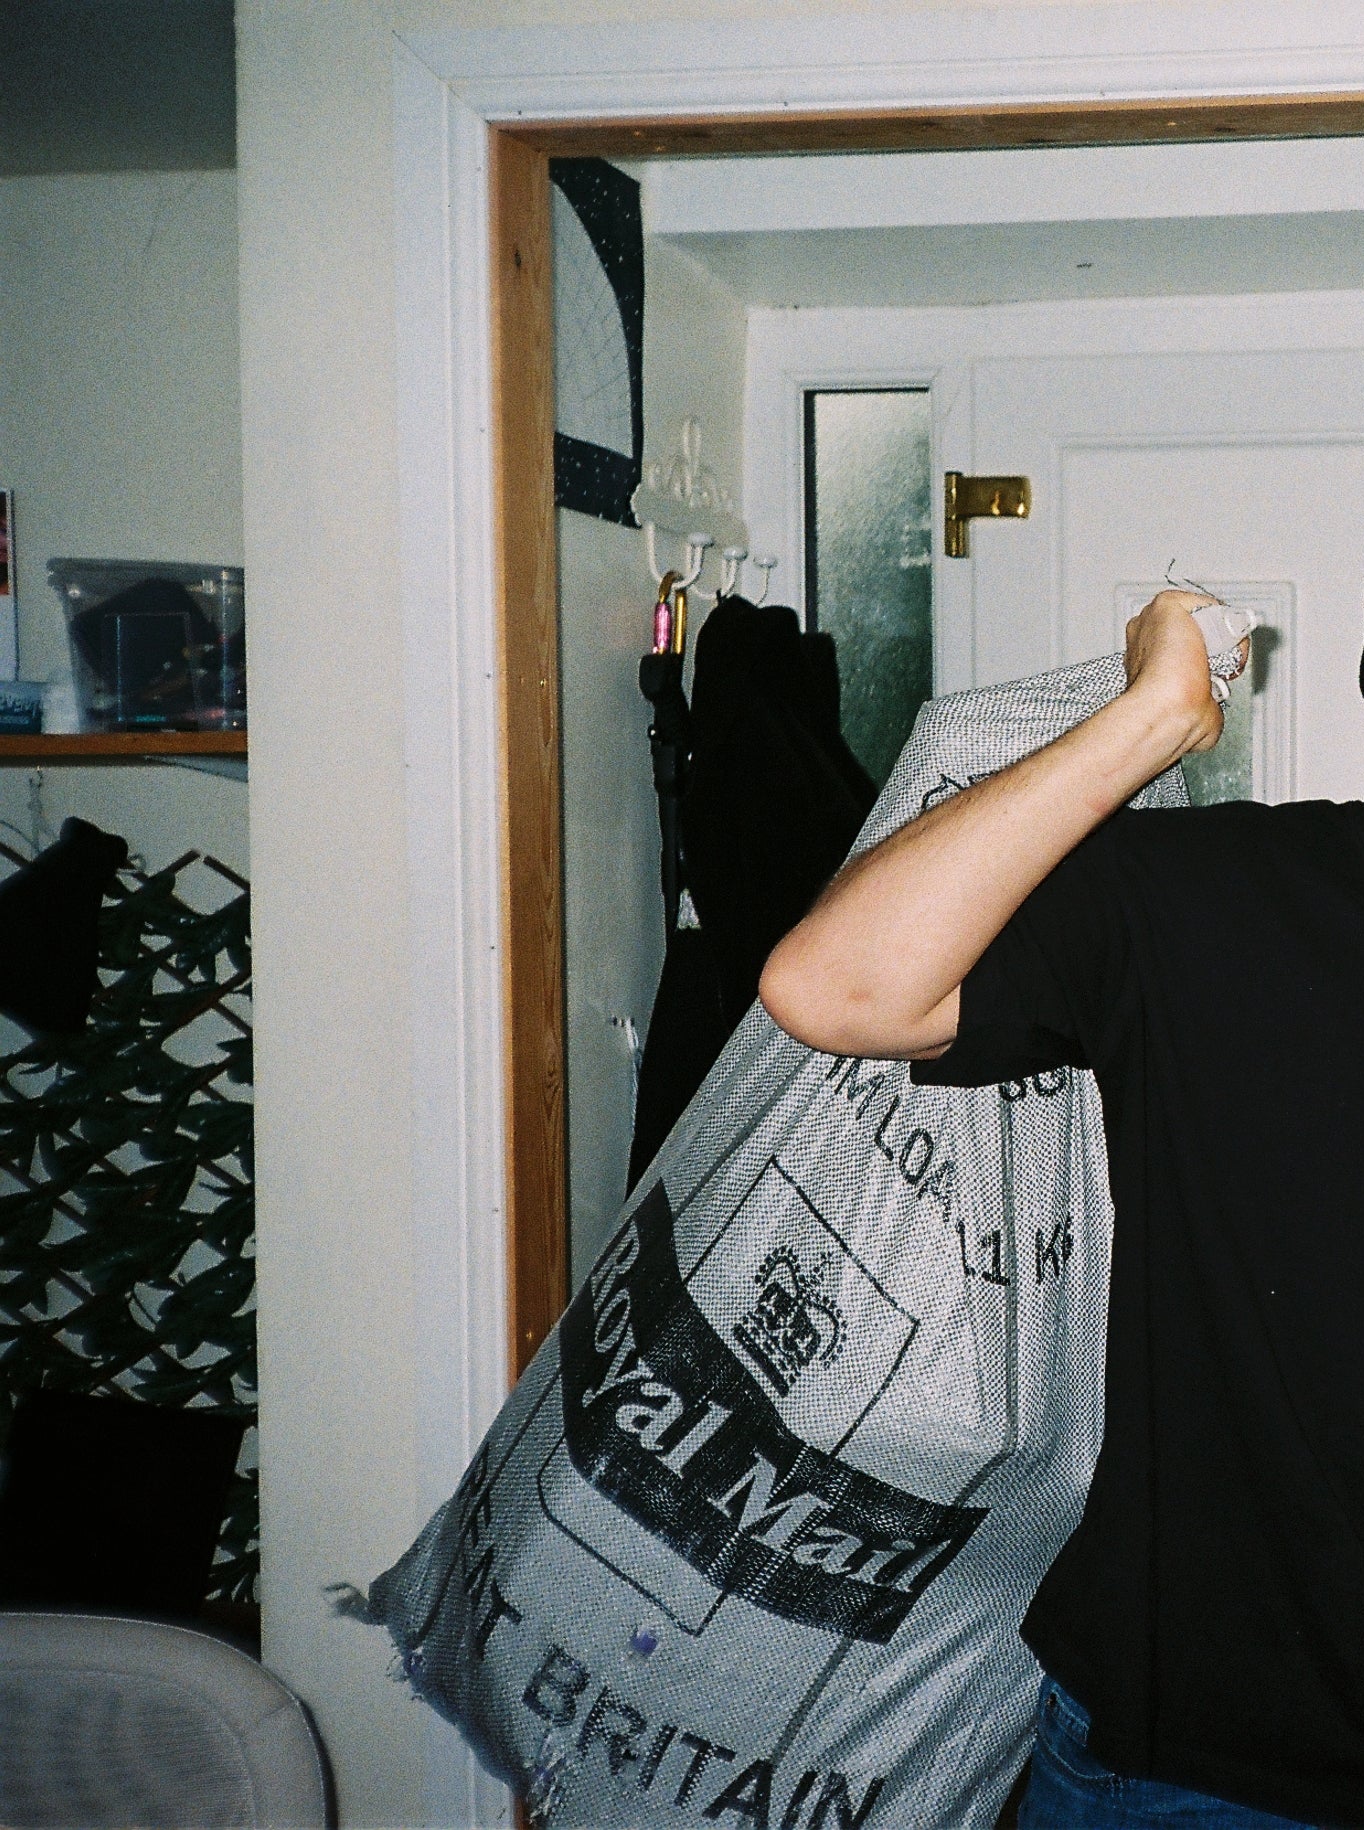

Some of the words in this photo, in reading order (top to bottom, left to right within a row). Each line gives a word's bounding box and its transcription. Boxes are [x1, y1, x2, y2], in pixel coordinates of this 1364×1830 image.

[582, 1221, 734, 1478] Royal
[708, 1451, 953, 1592] Mail
[522, 1644, 885, 1829] BRITAIN
